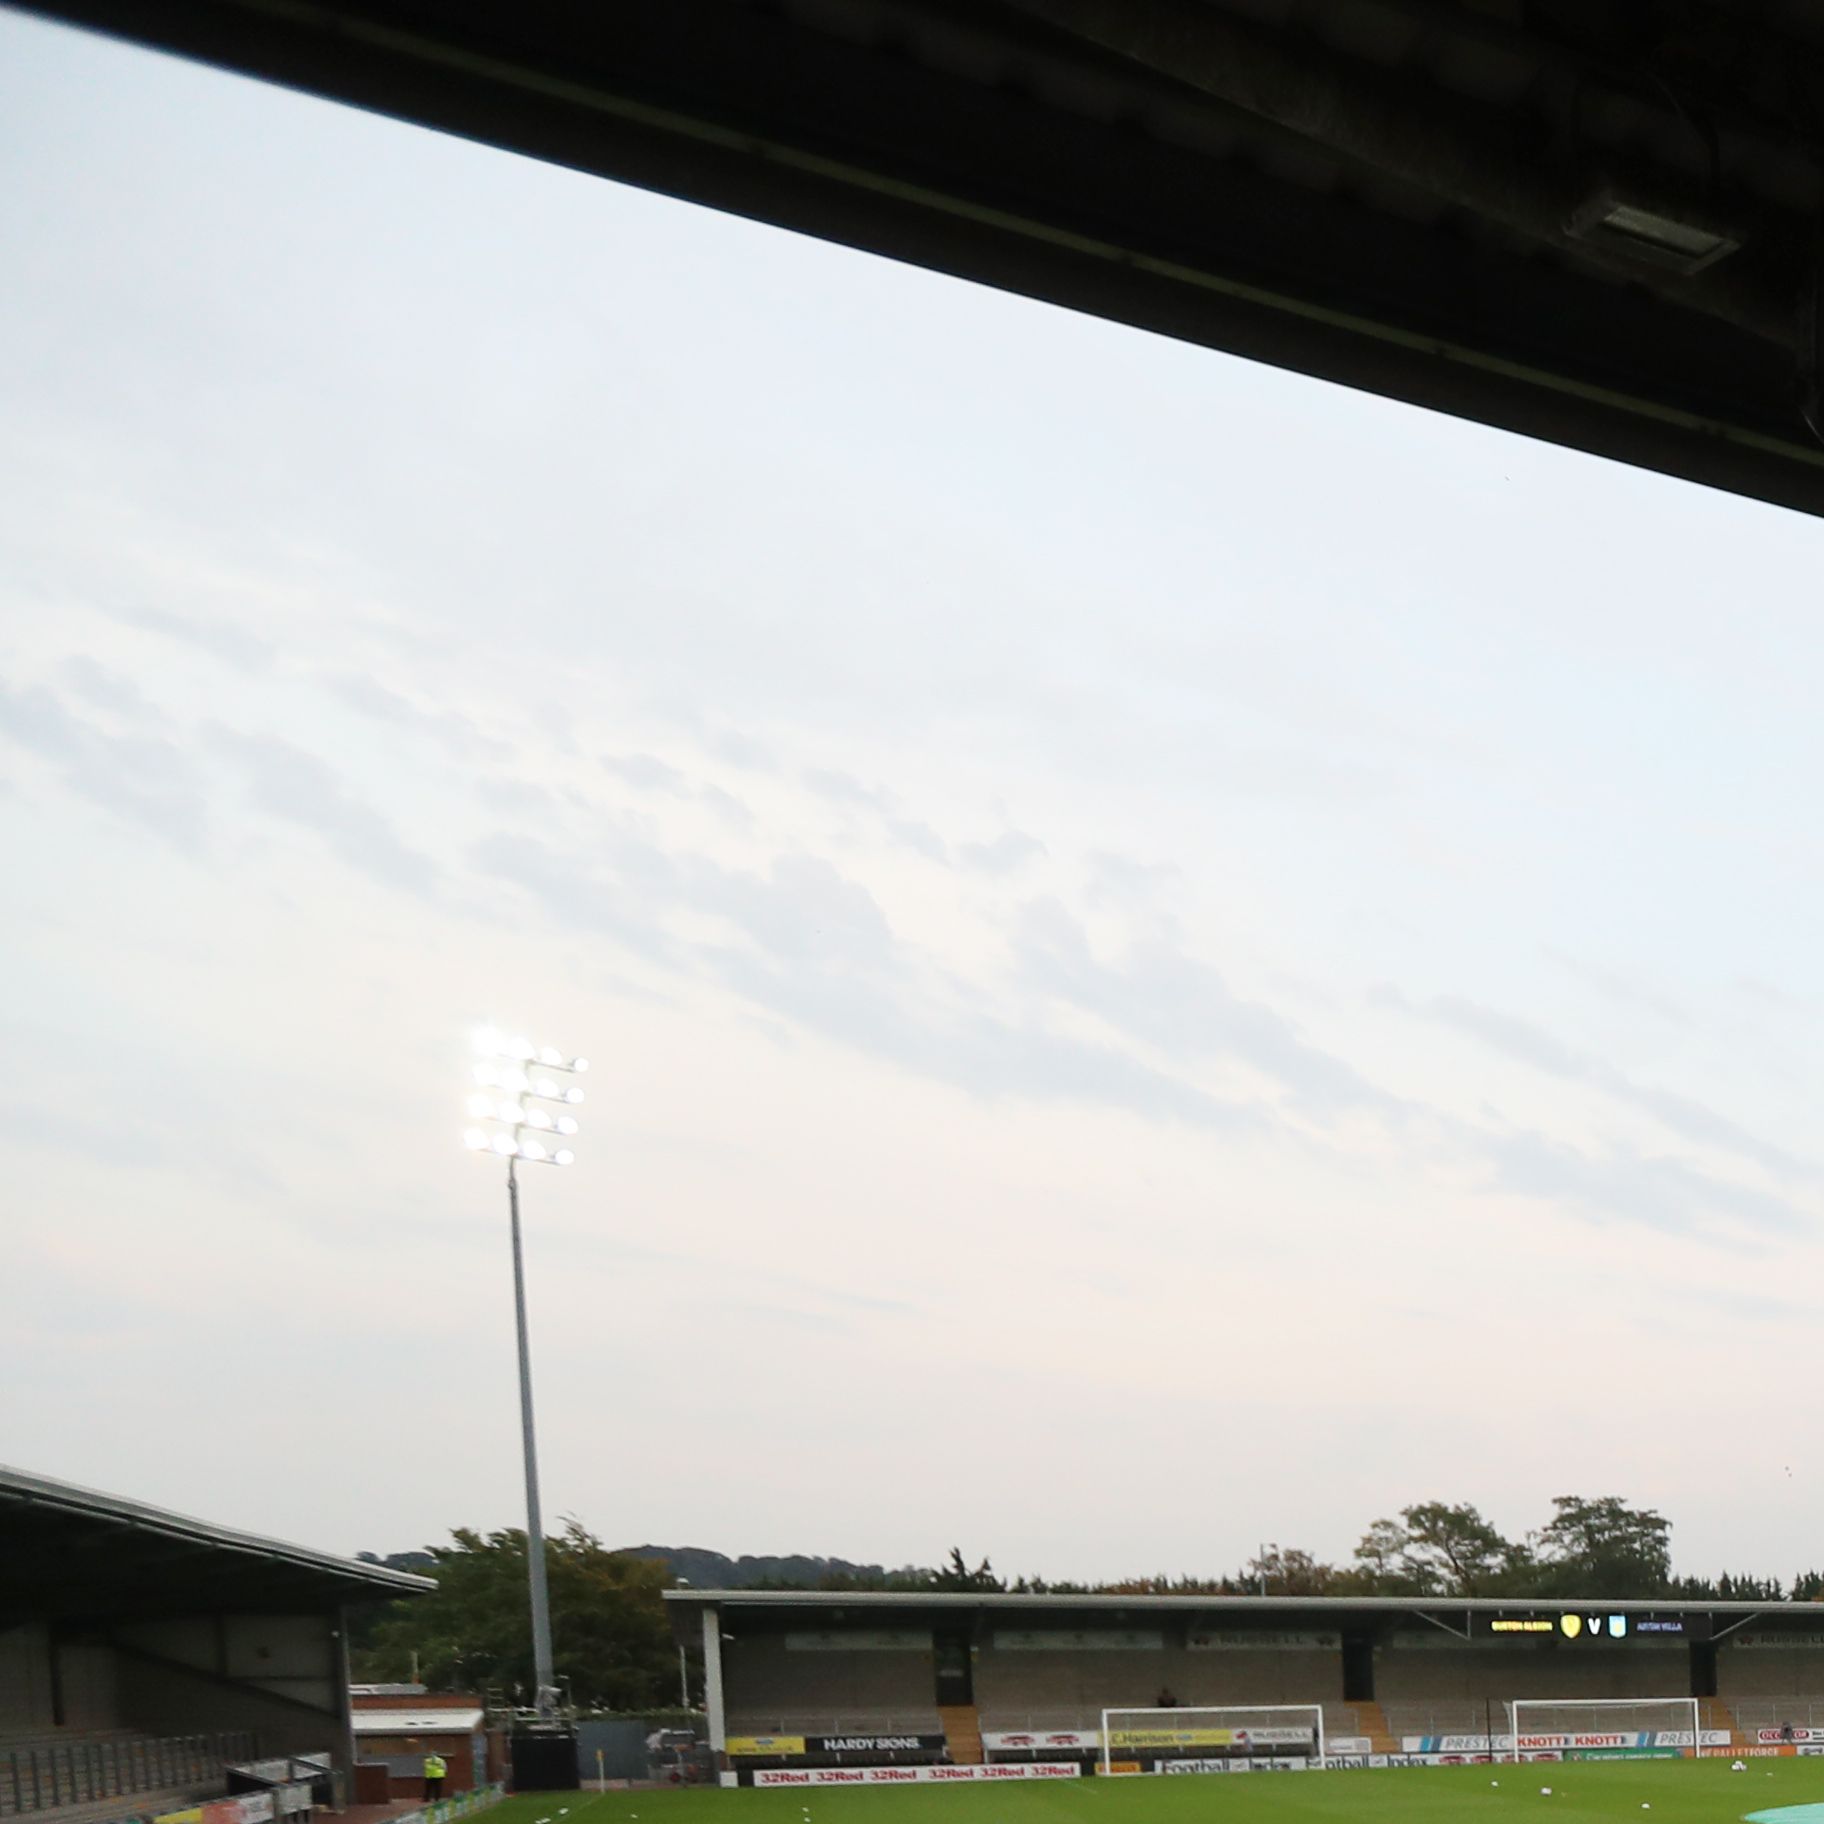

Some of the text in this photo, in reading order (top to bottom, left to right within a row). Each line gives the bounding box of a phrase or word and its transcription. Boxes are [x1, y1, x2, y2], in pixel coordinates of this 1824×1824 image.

[1517, 1736, 1563, 1747] KNOTT
[1575, 1736, 1617, 1746] KNOTT
[1659, 1732, 1718, 1745] PRESEC
[871, 1769, 917, 1781] 32Red
[928, 1768, 975, 1780] 32Red
[980, 1766, 1026, 1779] 32Red
[1031, 1764, 1076, 1777] 32Red
[761, 1772, 810, 1784] 32Red
[816, 1771, 864, 1783] 32Red
